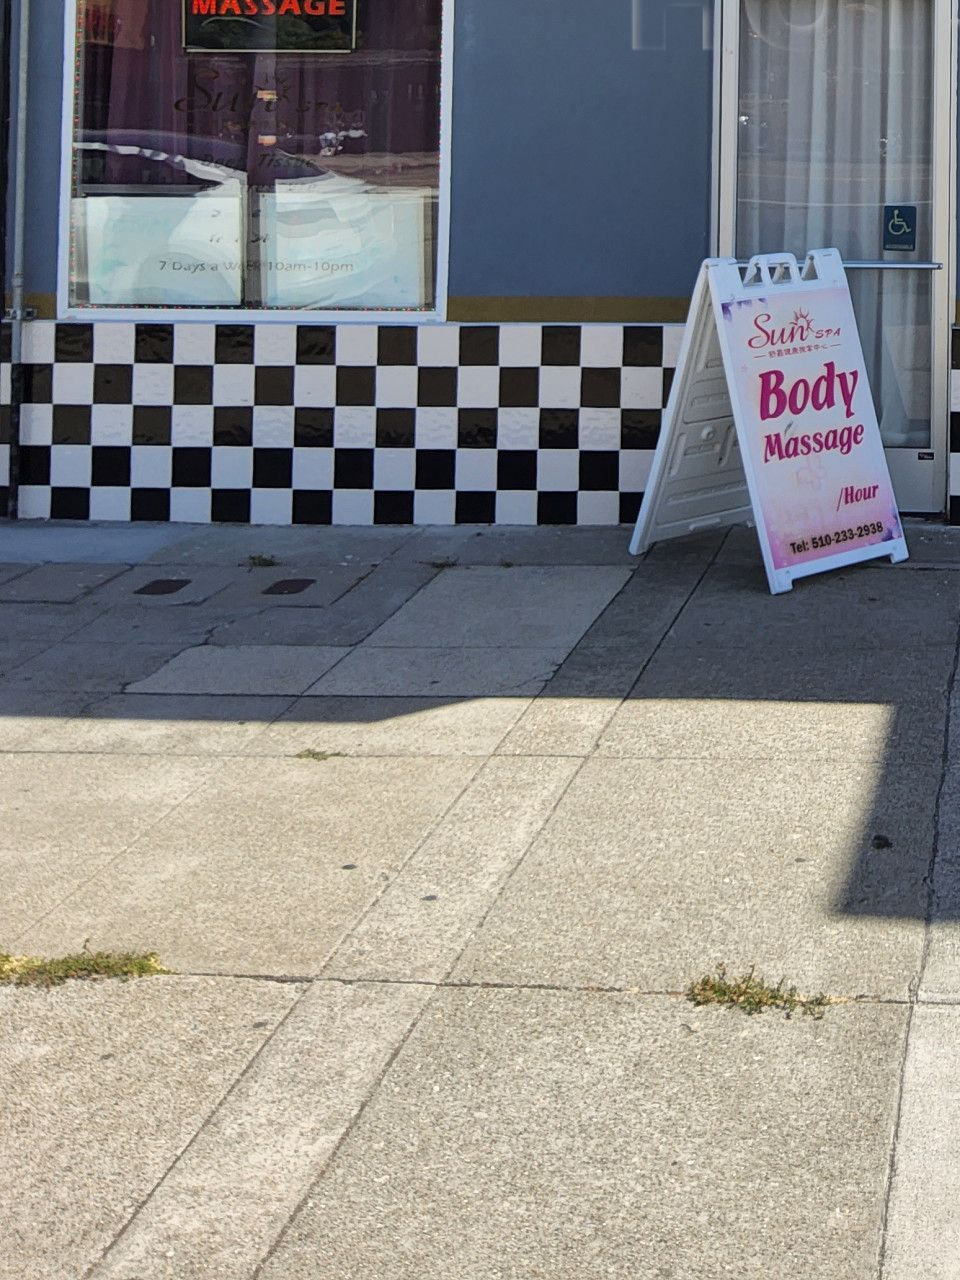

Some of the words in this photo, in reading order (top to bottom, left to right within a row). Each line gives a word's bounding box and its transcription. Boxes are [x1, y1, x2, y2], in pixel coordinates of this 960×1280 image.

[748, 313, 809, 349] Sun
[815, 327, 841, 339] SPA
[759, 362, 859, 421] Body
[763, 424, 865, 463] Massage
[836, 484, 879, 512] /Hour
[789, 541, 810, 555] Tel:
[811, 521, 884, 549] 510-233-2938
